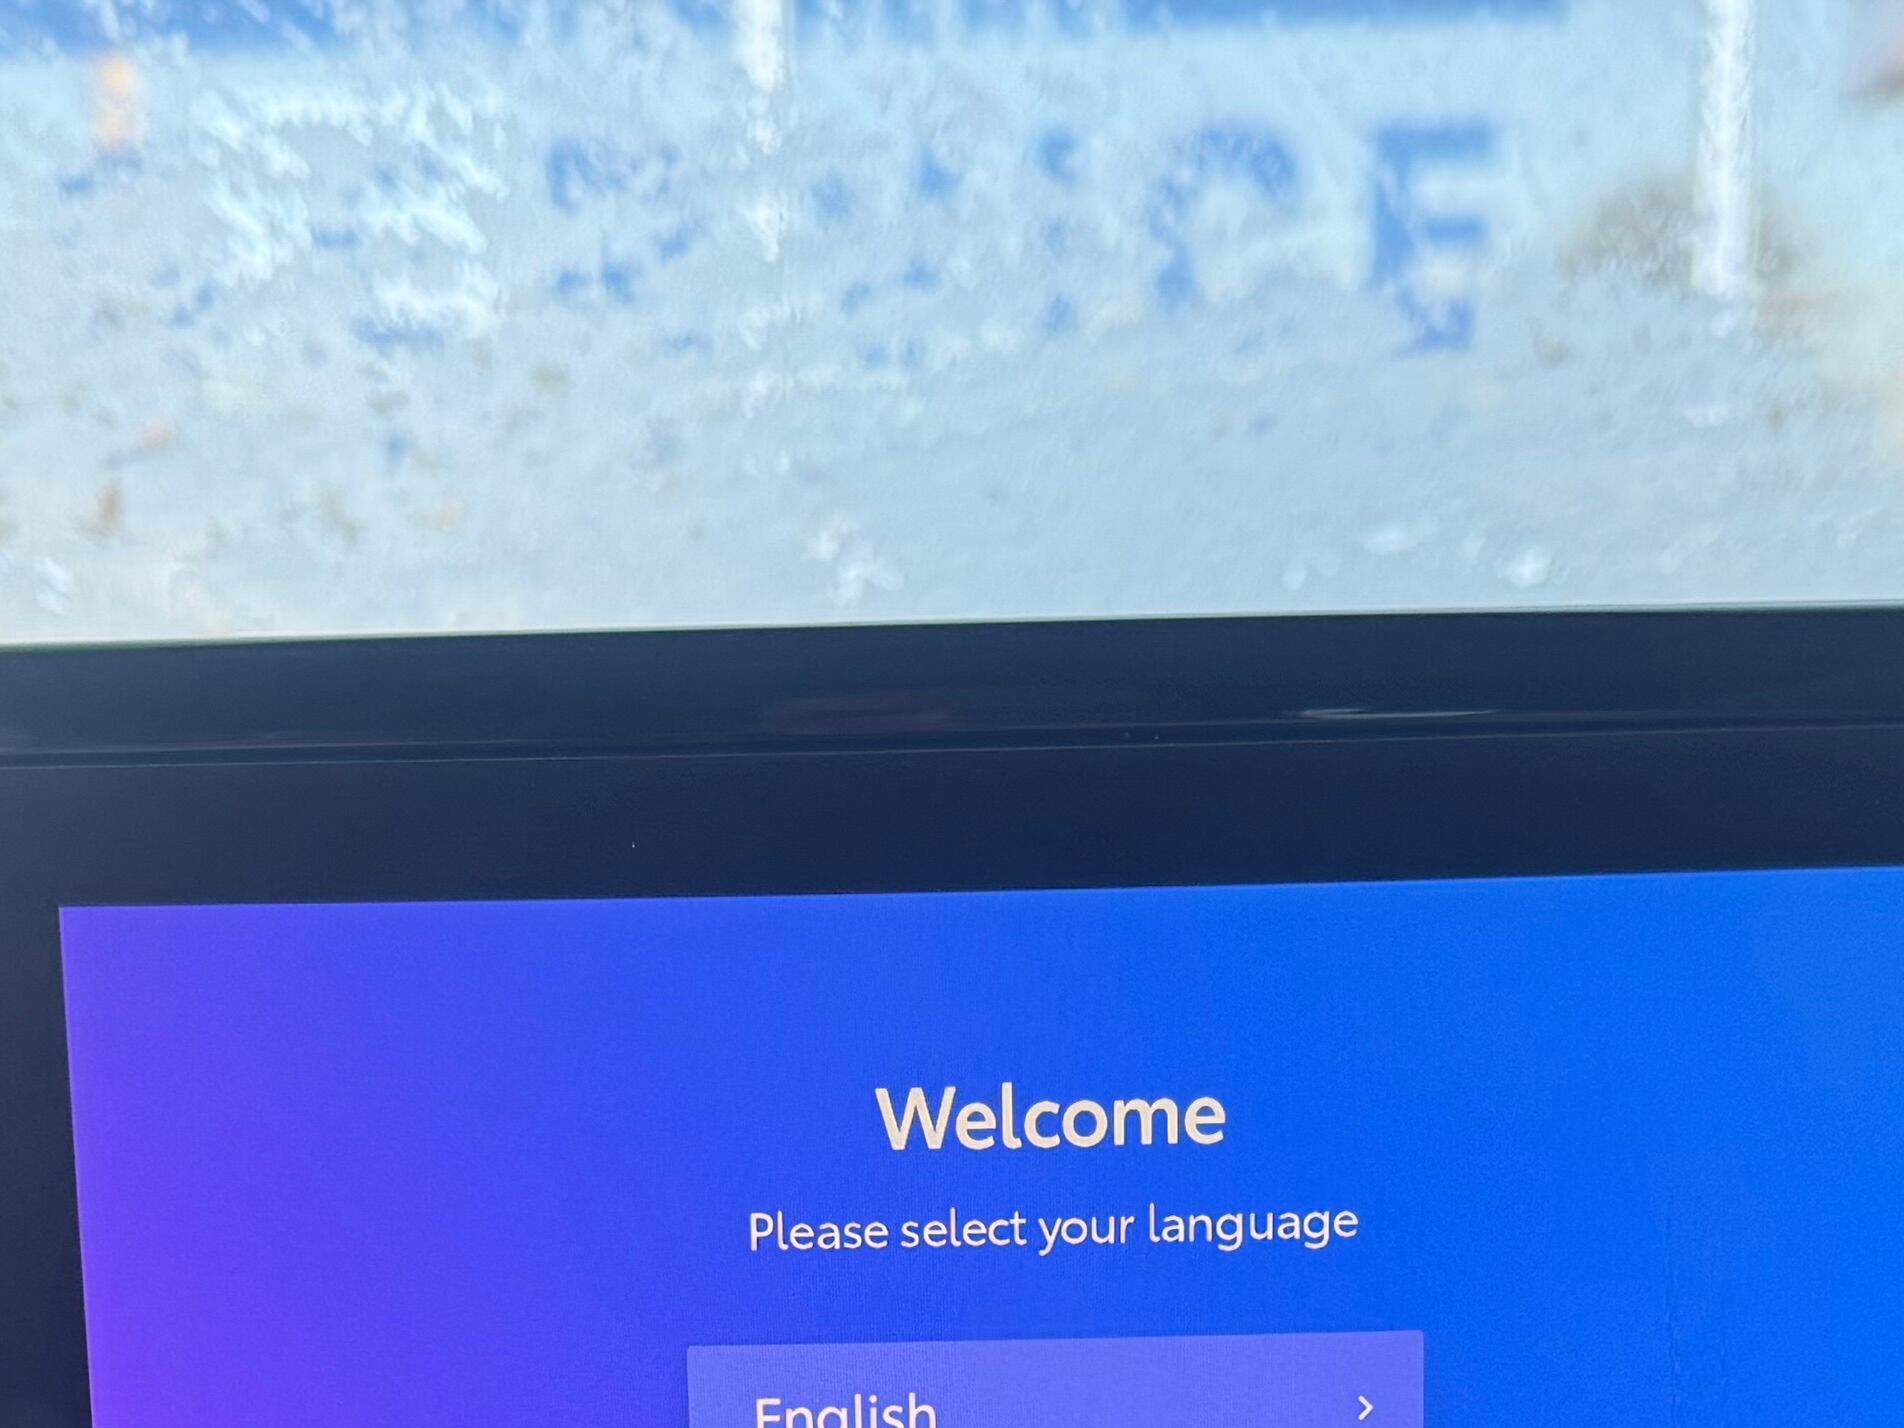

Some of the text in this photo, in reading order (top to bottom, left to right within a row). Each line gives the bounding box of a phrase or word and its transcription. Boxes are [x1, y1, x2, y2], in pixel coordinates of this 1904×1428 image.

[875, 1081, 1227, 1152] Welcome
[748, 1203, 1360, 1257] Please select your language
